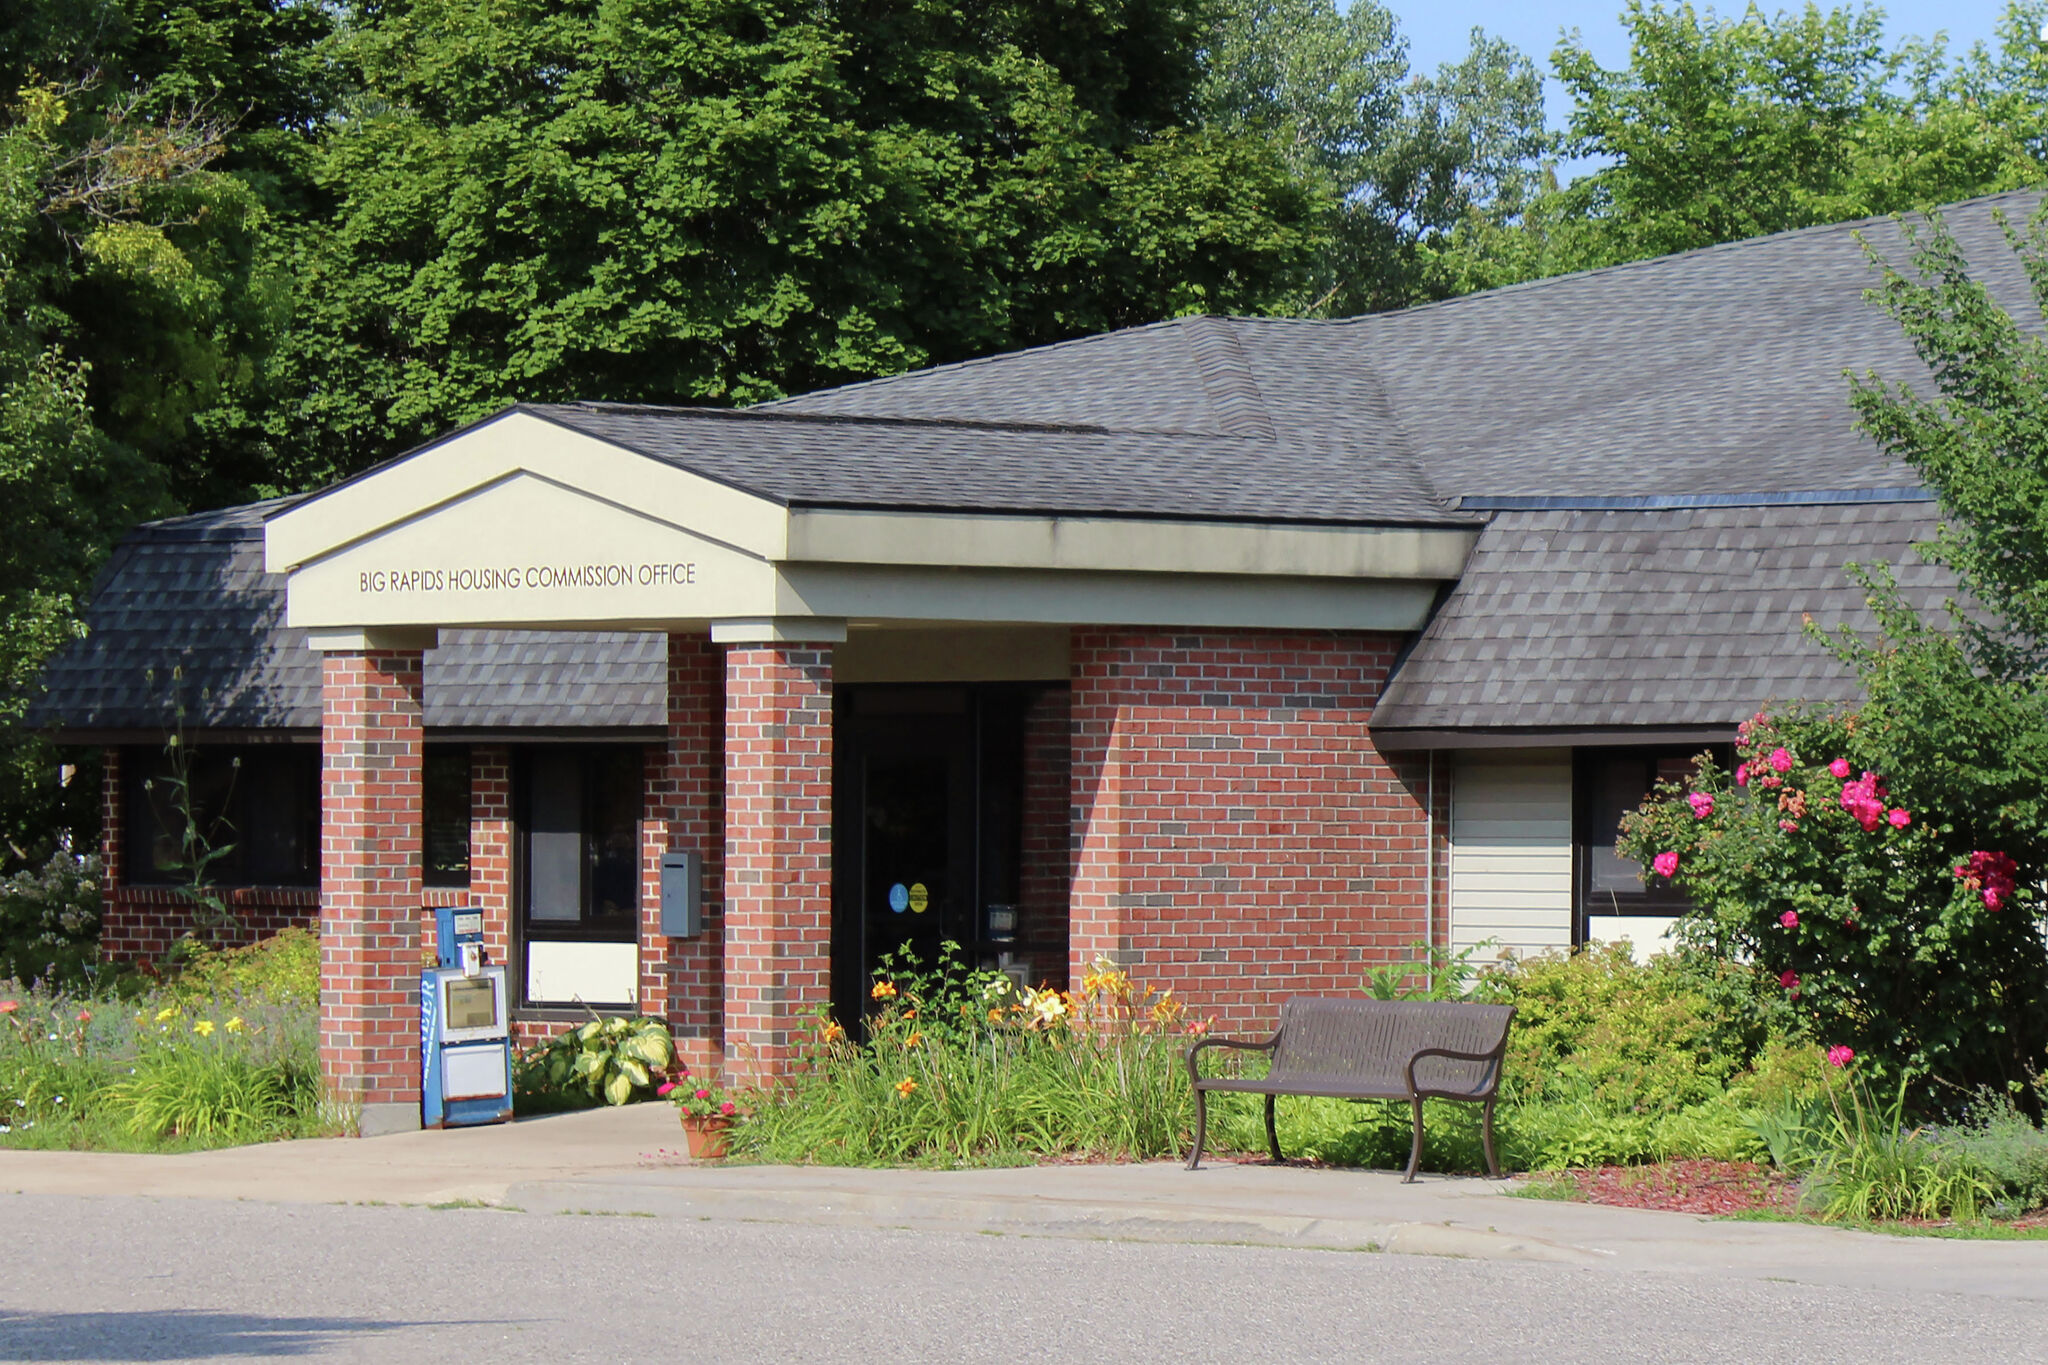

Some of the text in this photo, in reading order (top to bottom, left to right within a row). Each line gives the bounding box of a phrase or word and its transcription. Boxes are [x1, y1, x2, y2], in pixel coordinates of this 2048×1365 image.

[360, 563, 696, 592] BIG RAPIDS HOUSING COMMISSION OFFICE
